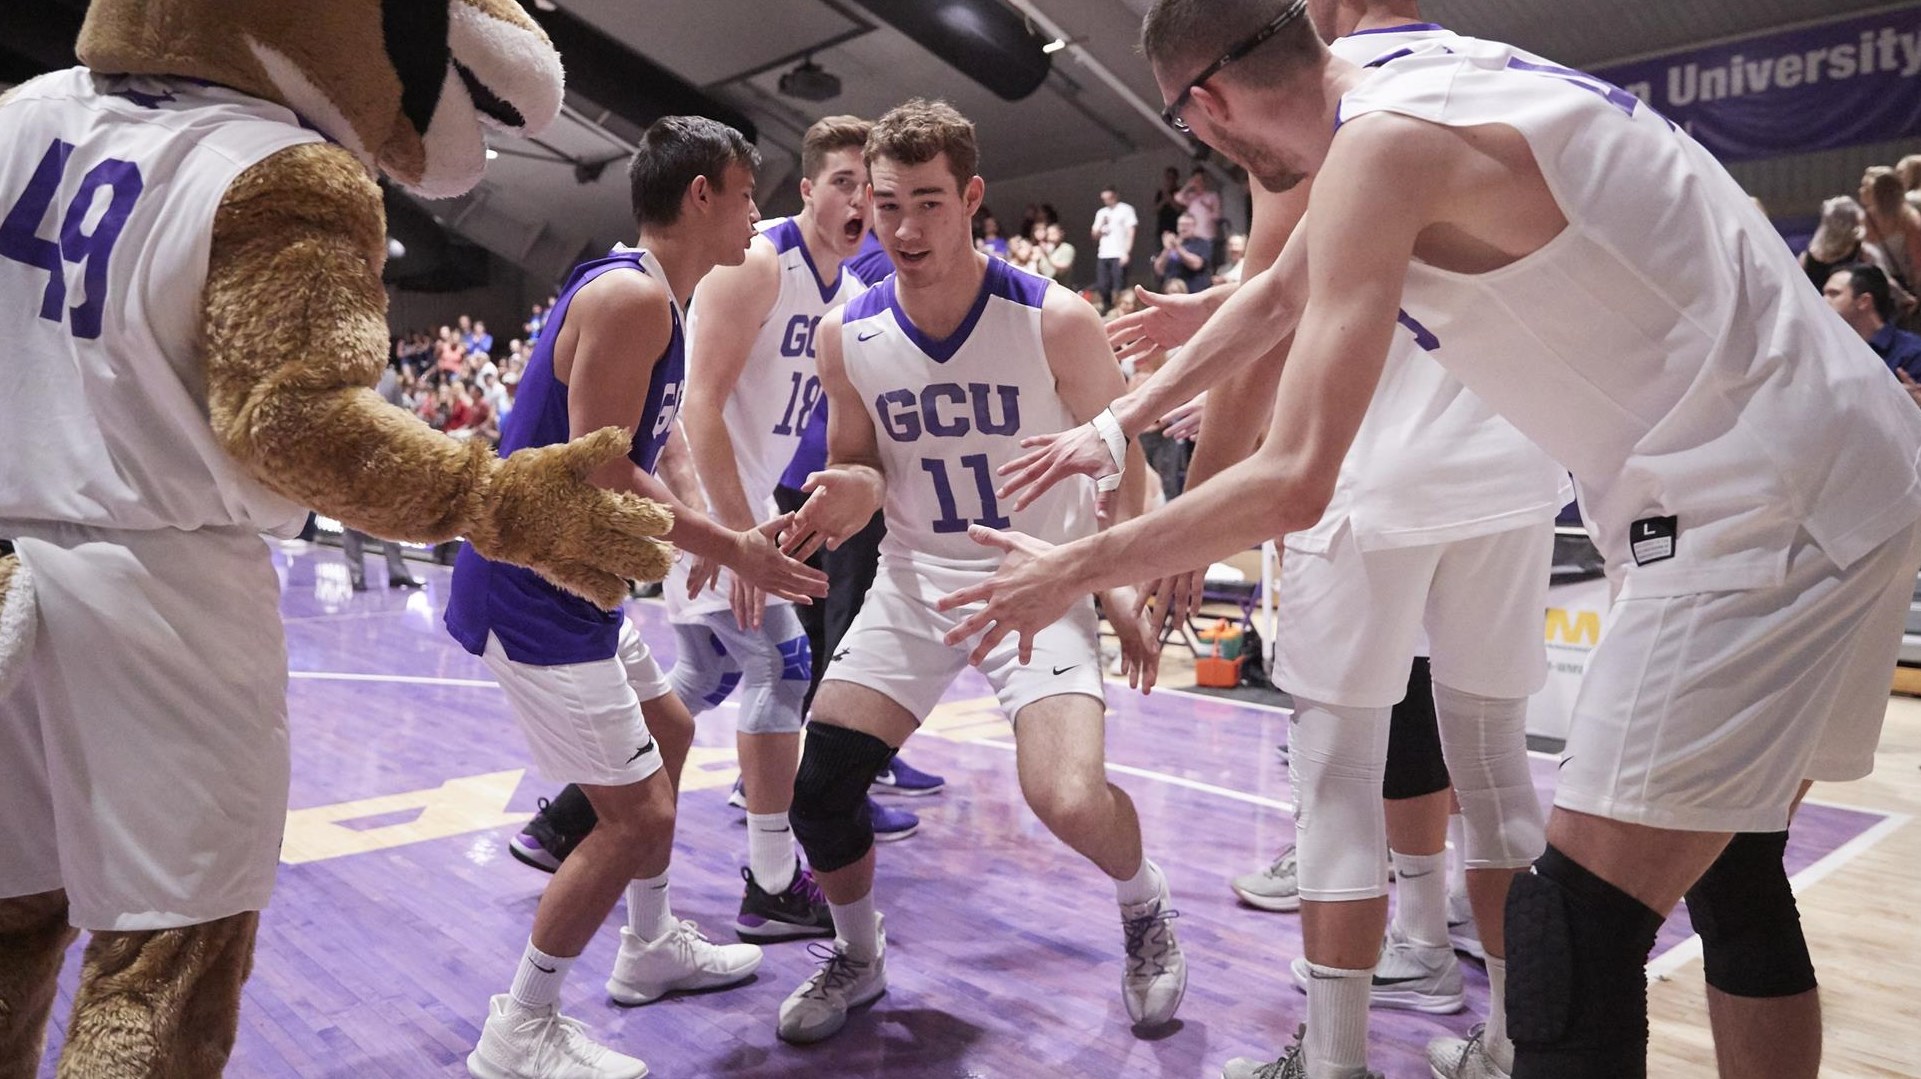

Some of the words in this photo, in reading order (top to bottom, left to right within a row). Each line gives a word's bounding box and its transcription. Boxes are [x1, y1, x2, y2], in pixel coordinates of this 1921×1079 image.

[1667, 27, 1921, 107] University
[0, 137, 144, 340] 49
[772, 371, 822, 437] 18
[875, 382, 1021, 442] GCU
[921, 453, 1011, 533] 11
[1643, 523, 1656, 535] L
